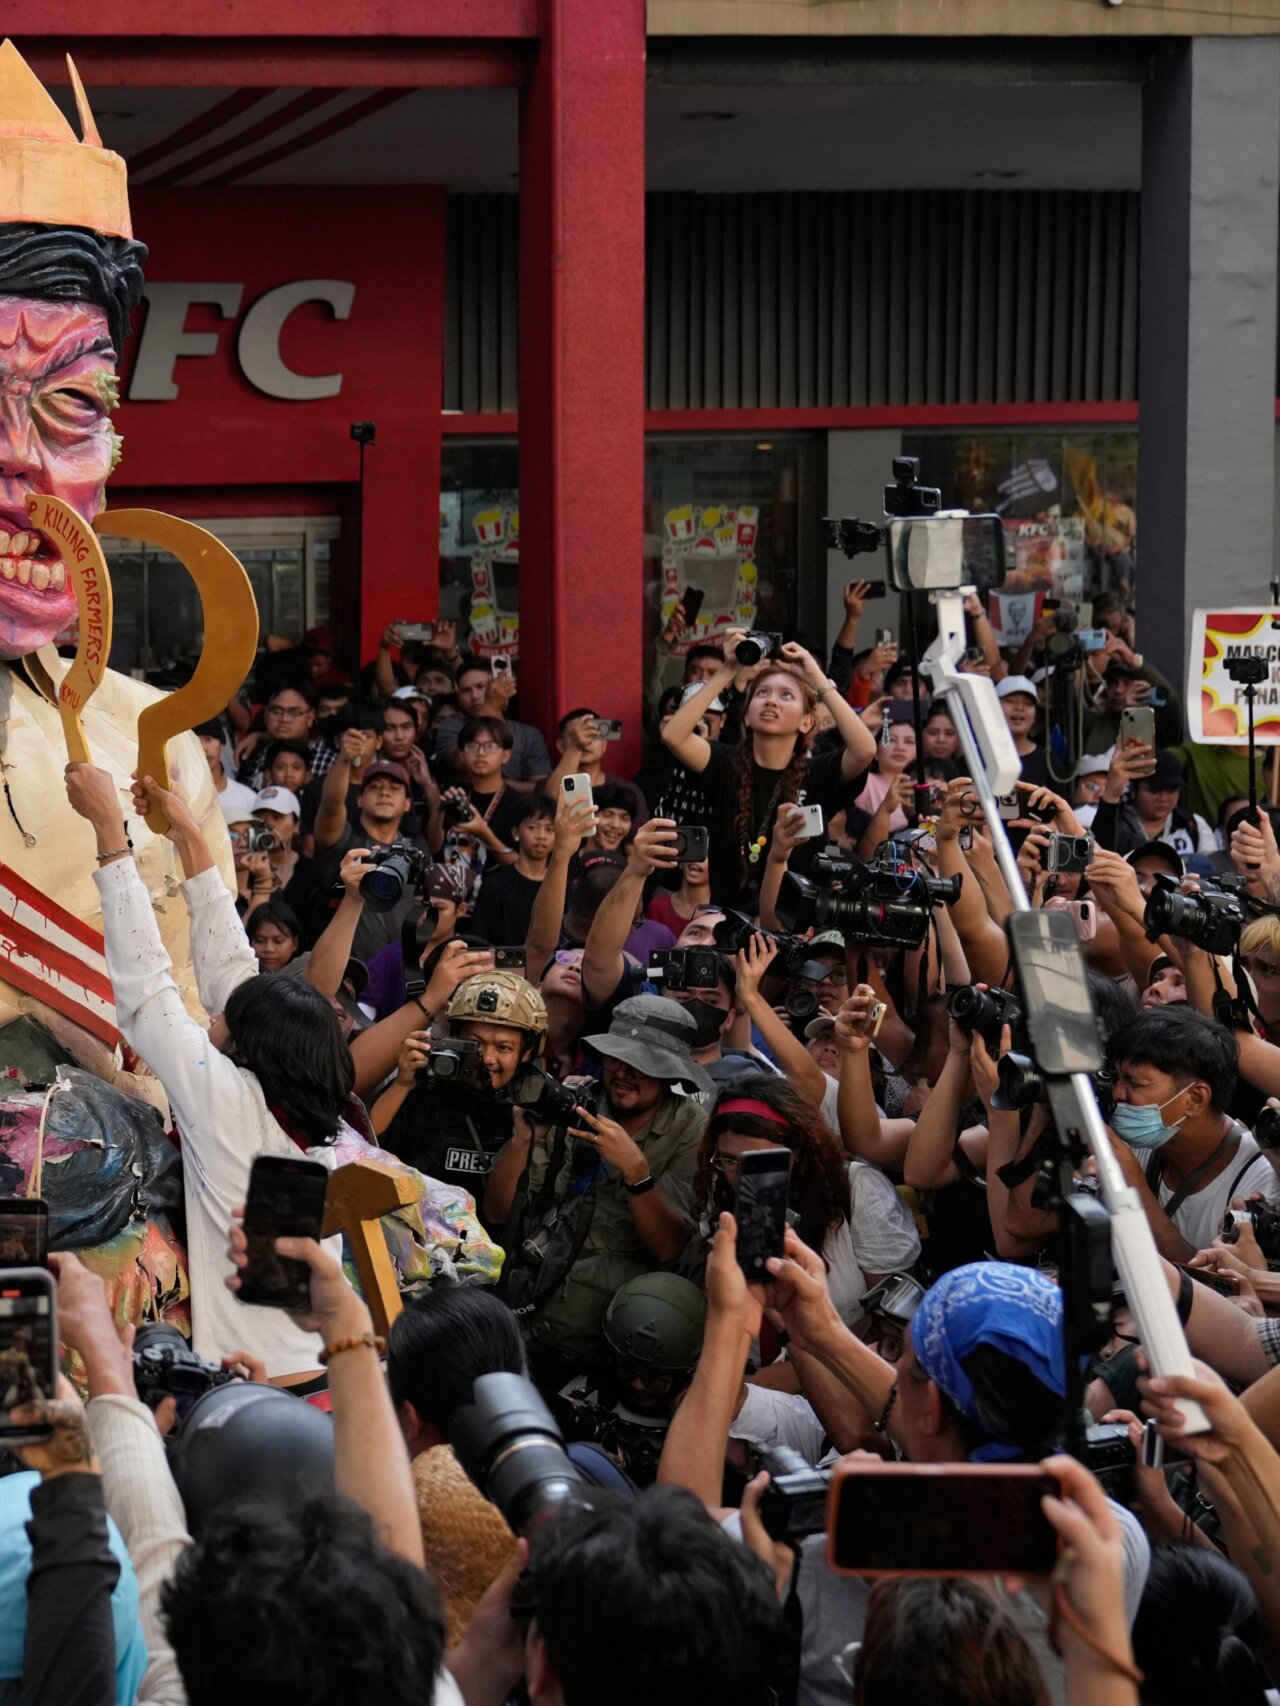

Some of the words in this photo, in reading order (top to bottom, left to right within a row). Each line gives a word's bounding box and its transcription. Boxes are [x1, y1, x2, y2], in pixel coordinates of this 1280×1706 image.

[128, 278, 357, 401] FC
[42, 503, 90, 564] KILLING
[1018, 522, 1050, 537] KFC
